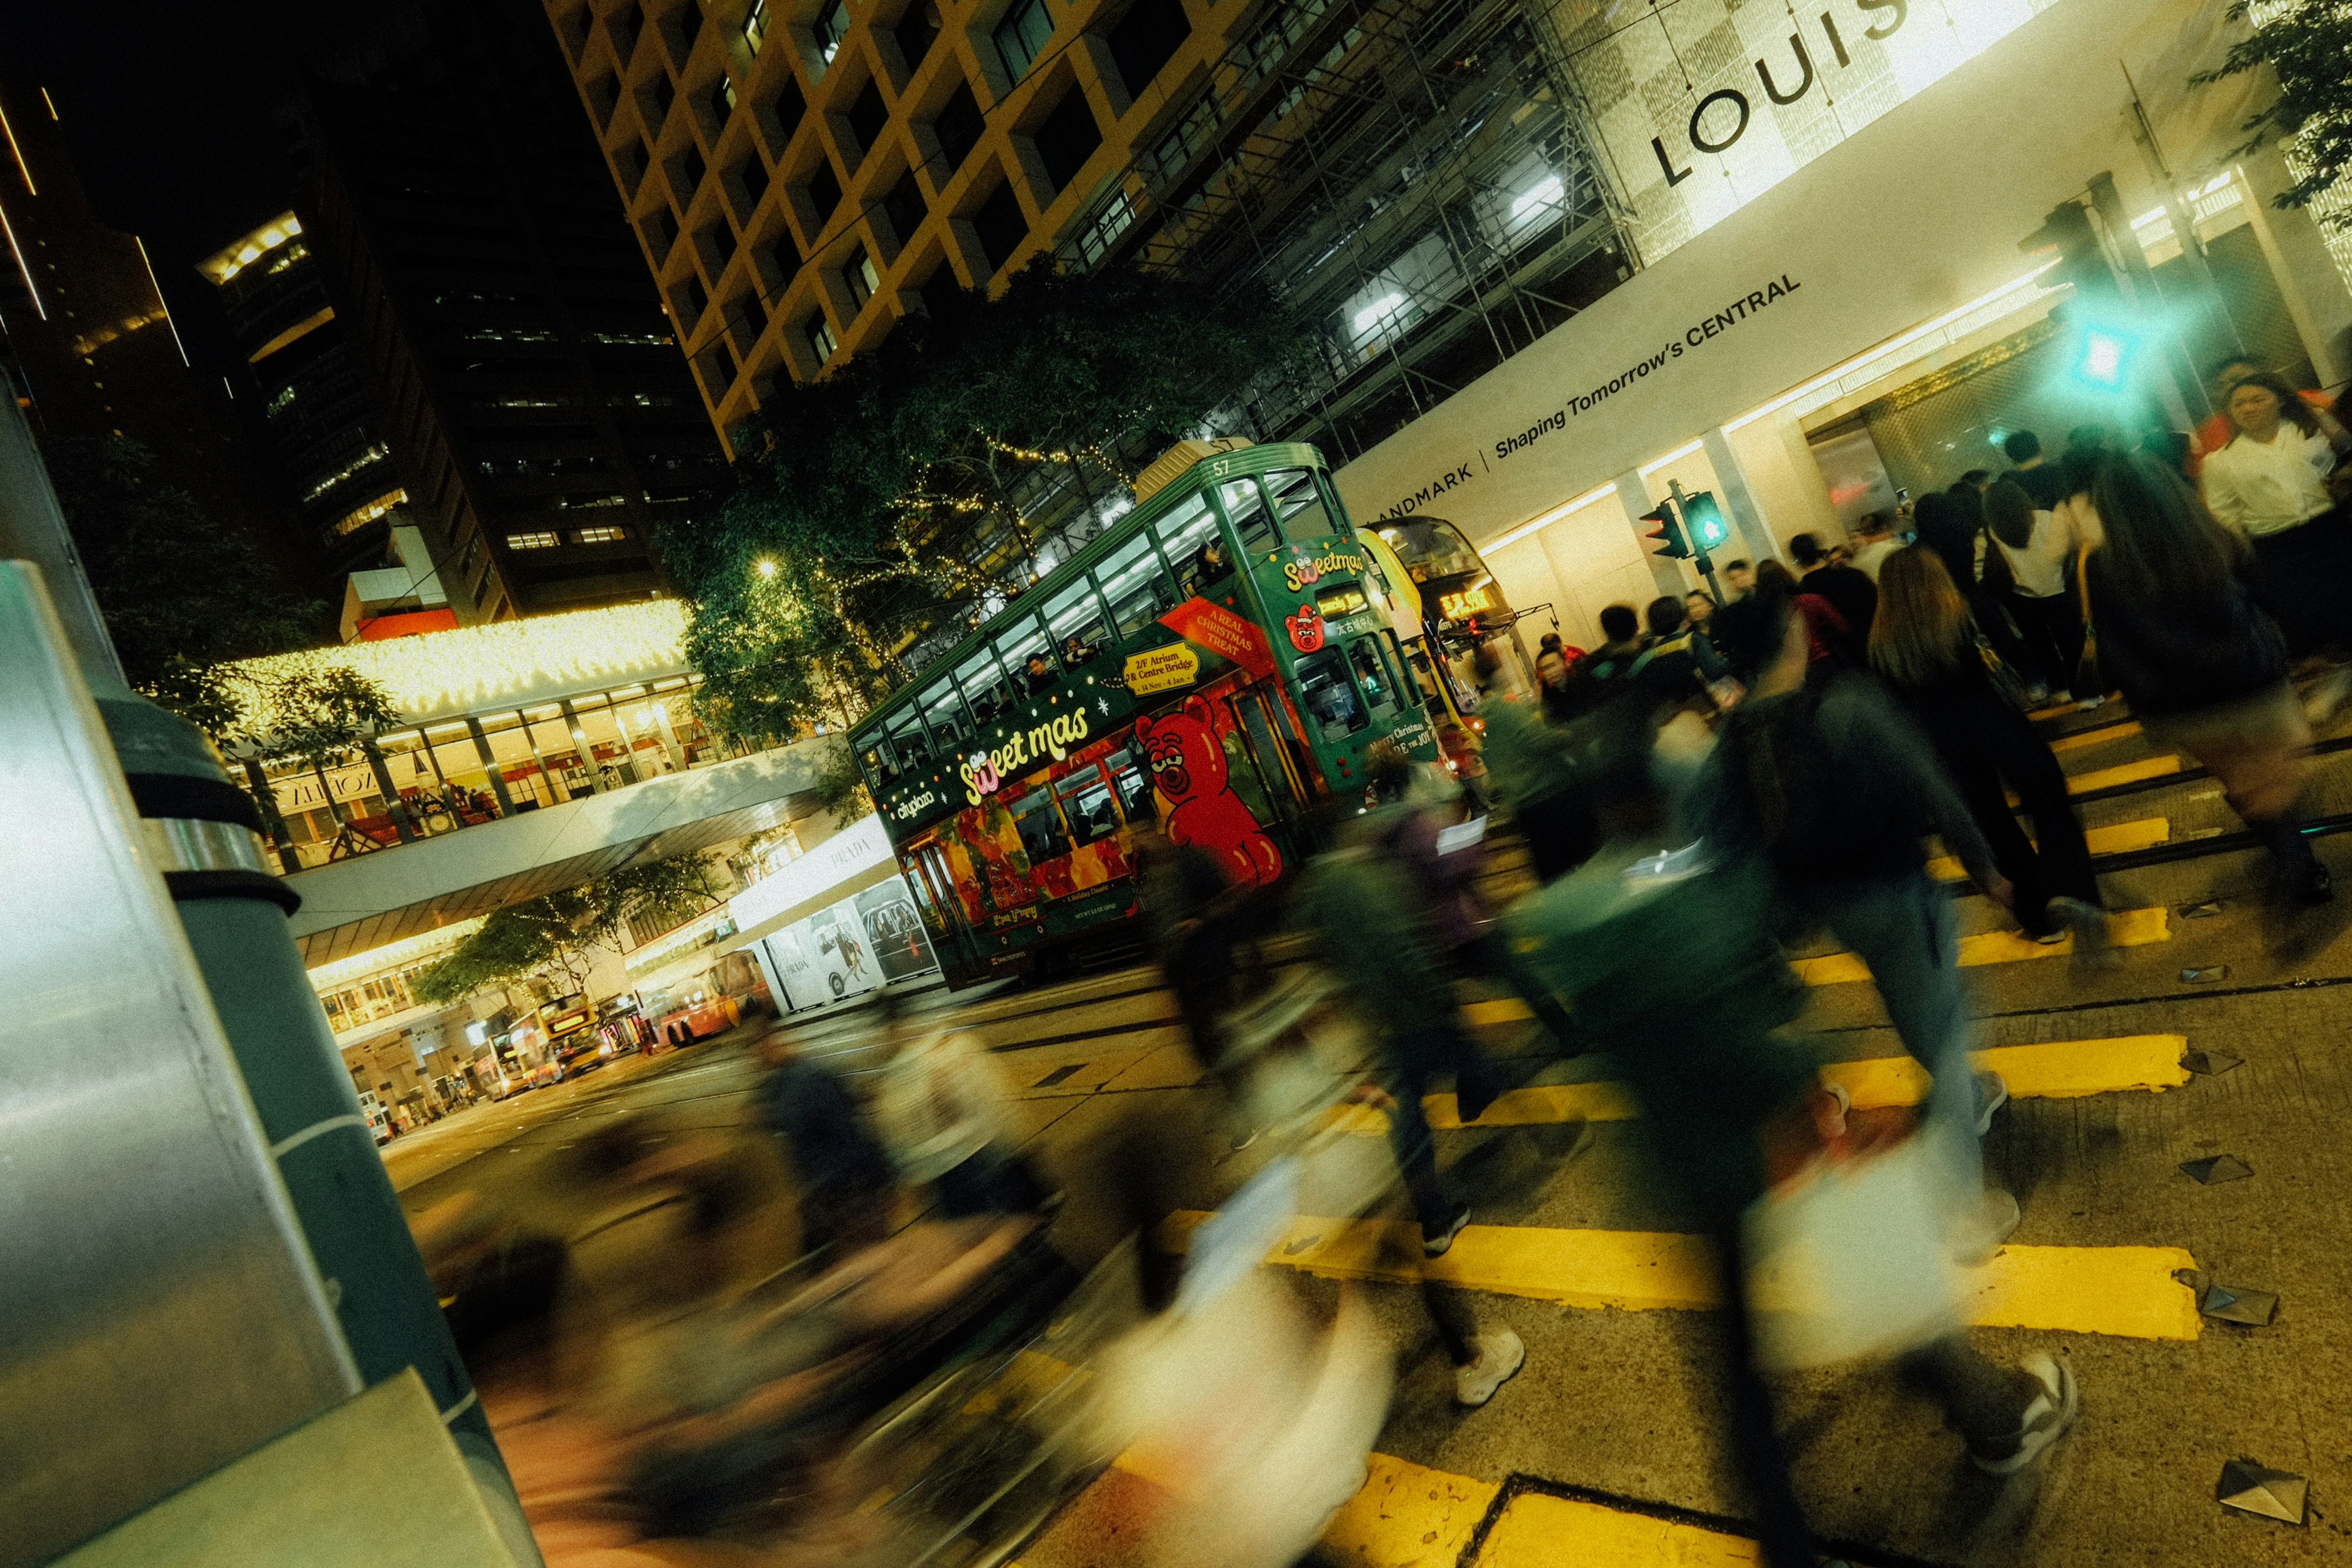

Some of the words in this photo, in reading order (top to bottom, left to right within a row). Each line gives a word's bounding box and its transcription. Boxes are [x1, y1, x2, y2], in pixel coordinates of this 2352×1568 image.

[1652, 0, 1908, 187] LOUIS
[1366, 463, 1473, 525] NDMARK
[1495, 410, 1566, 459] Shaping
[1567, 343, 1684, 416] Tomorrow's
[1685, 274, 1801, 347] CENTRAL
[1213, 459, 1229, 477] 57
[1284, 551, 1363, 591] Sweetmas
[1197, 616, 1252, 651] CHRISTMAS
[1210, 610, 1217, 620] A
[1218, 612, 1243, 634] REAL
[1336, 615, 1373, 636] 太古城中心
[1207, 633, 1239, 656] TREAT
[1130, 673, 1137, 681] &
[1139, 668, 1165, 680] Centre
[1166, 659, 1193, 673] Bridge
[1135, 658, 1148, 670] 2/F
[1150, 652, 1179, 666] Atrium
[1148, 681, 1162, 691] Nov
[1369, 733, 1395, 754] Merry
[1394, 723, 1424, 739] Christmas
[1408, 740, 1419, 748] THE
[1418, 730, 1431, 746] JOY
[897, 791, 935, 820] cityplaza
[831, 838, 871, 868] PRADA
[1071, 891, 1090, 901] Holiday
[1090, 884, 1109, 894] Classic
[785, 959, 809, 975] PRADA
